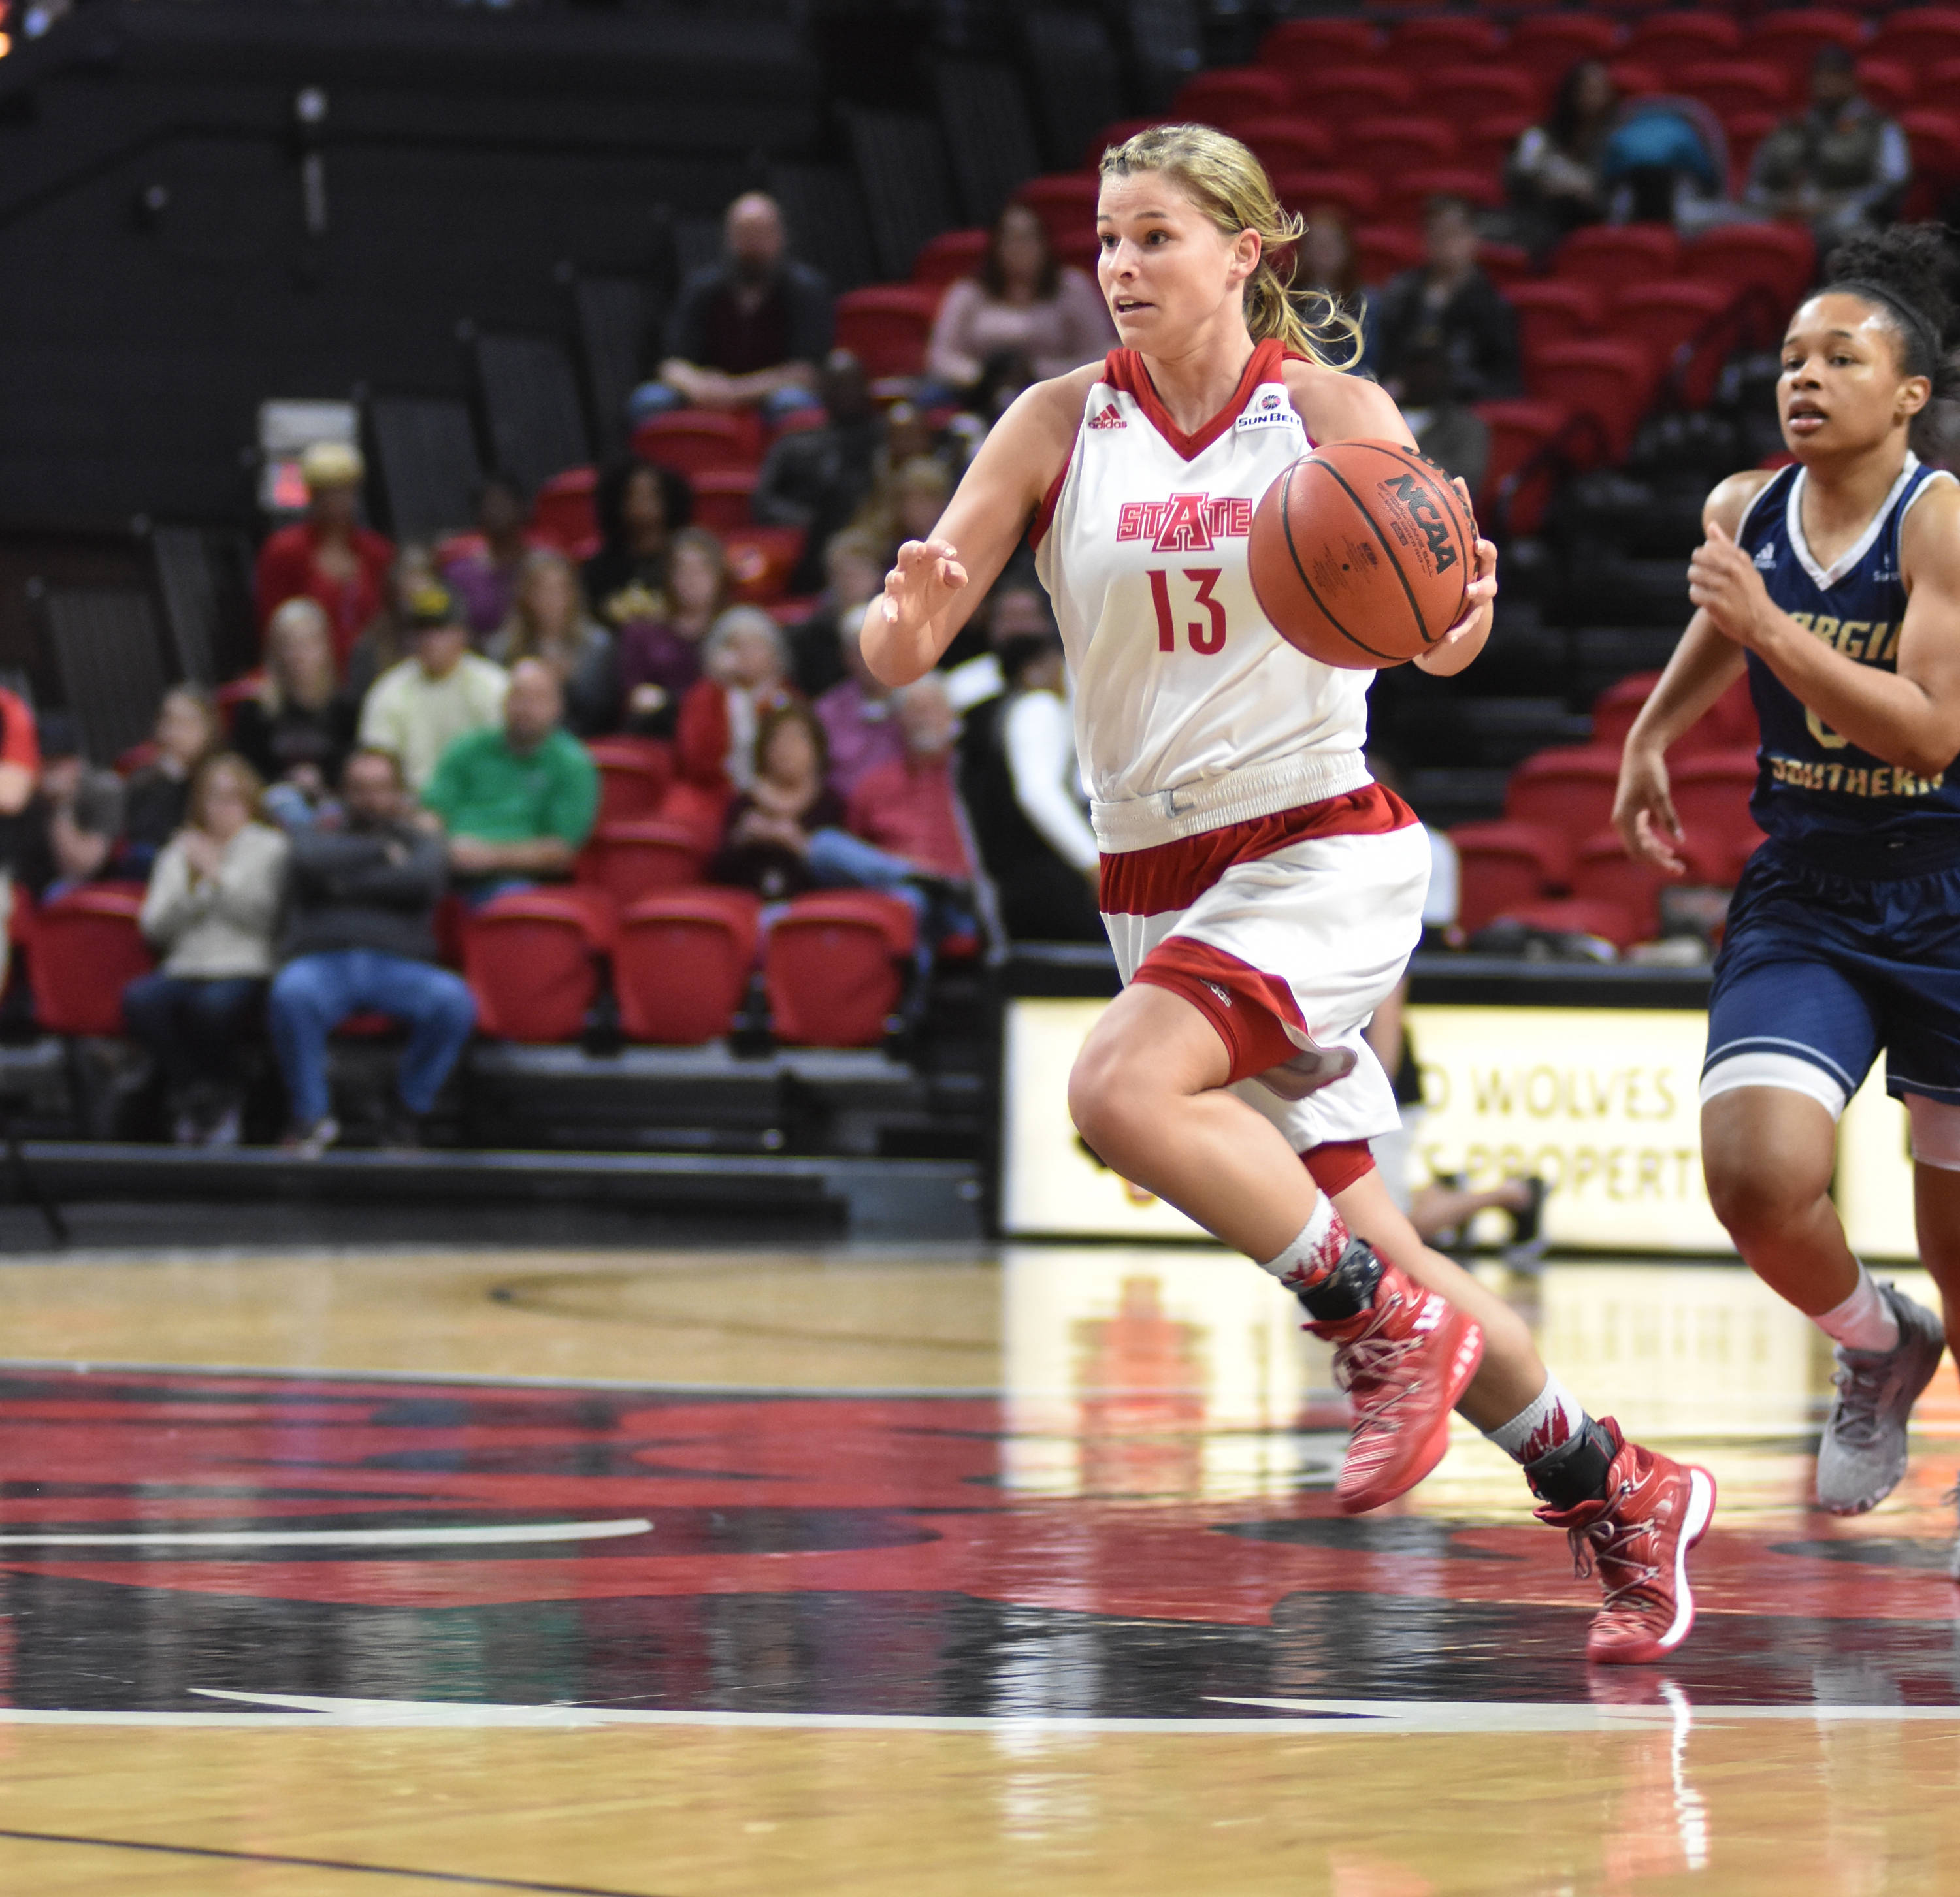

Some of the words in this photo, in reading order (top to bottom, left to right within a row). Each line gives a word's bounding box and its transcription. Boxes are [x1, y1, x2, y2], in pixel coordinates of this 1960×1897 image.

[1088, 419, 1127, 429] adidas
[1239, 415, 1267, 427] SUN
[1116, 493, 1252, 553] STATE
[1384, 474, 1458, 575] NCAA
[1145, 568, 1226, 655] 13
[1470, 1063, 1677, 1119] WOLVES
[1465, 1144, 1703, 1202] PROPERT
